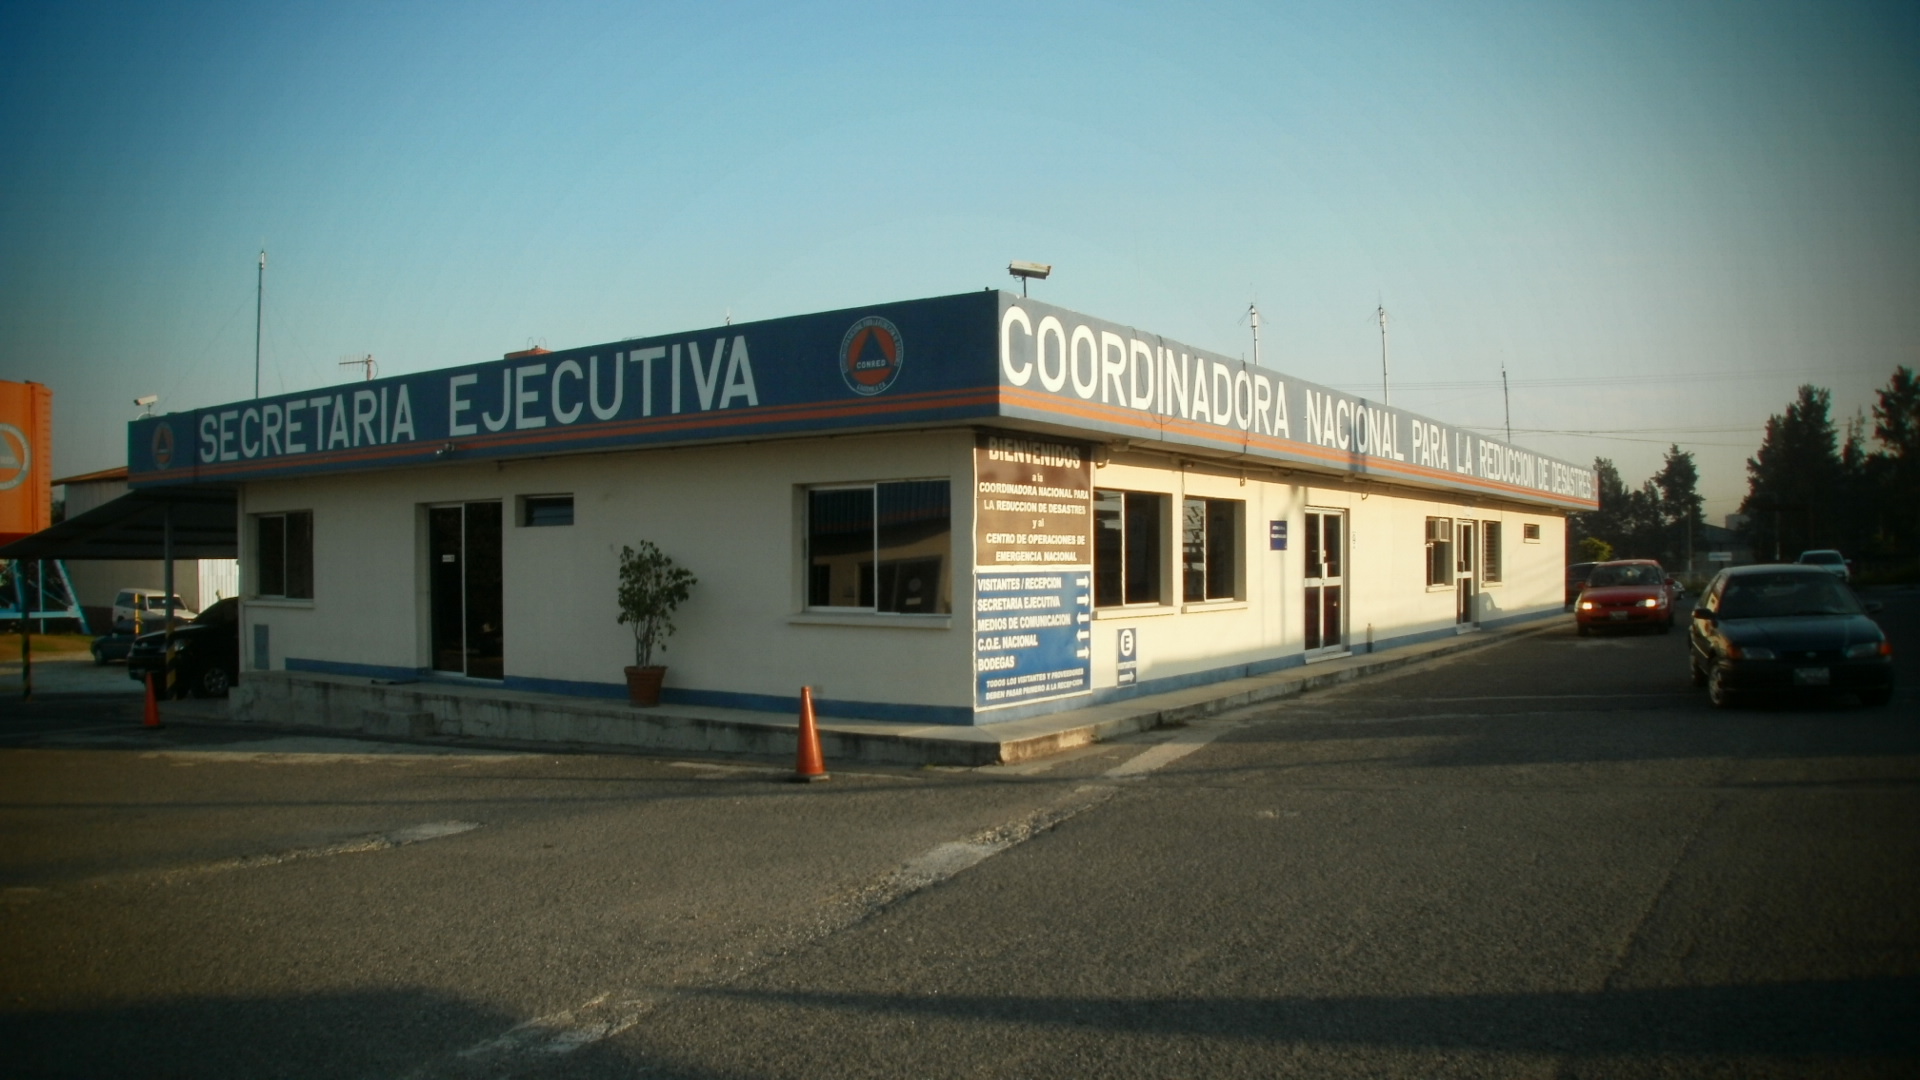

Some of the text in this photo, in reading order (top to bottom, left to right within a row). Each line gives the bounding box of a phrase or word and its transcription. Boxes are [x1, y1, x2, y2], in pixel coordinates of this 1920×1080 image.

[201, 384, 415, 463] SECRETARIA
[449, 335, 759, 436] EJECUTIVA
[1001, 306, 1591, 498] COORDINADORA NACIONAL PARA LA REDUCCION DE DESASTRES
[988, 437, 1080, 469] BIENVENIDOS
[1037, 473, 1043, 482] la
[979, 482, 1089, 500] COORDINADORA NACIONAL PARA
[984, 500, 1086, 515] LA REDUCCION DE DESASTRES
[1032, 519, 1037, 529] y
[986, 533, 1085, 545] CENTRO DE OPERACIONES DE
[996, 551, 1077, 562] EMERGENCIA NACIONAL
[977, 578, 1020, 591] VISITANTES
[1025, 577, 1062, 590] RECEPCION
[977, 595, 1061, 612] SECRETARIA EJECUTIVA
[977, 613, 1071, 632] MEDIOS DE COMUNICACION
[978, 634, 1038, 651] C.O.E. NACIONAL
[1123, 635, 1130, 651] E
[978, 655, 1015, 671] BODEGAS
